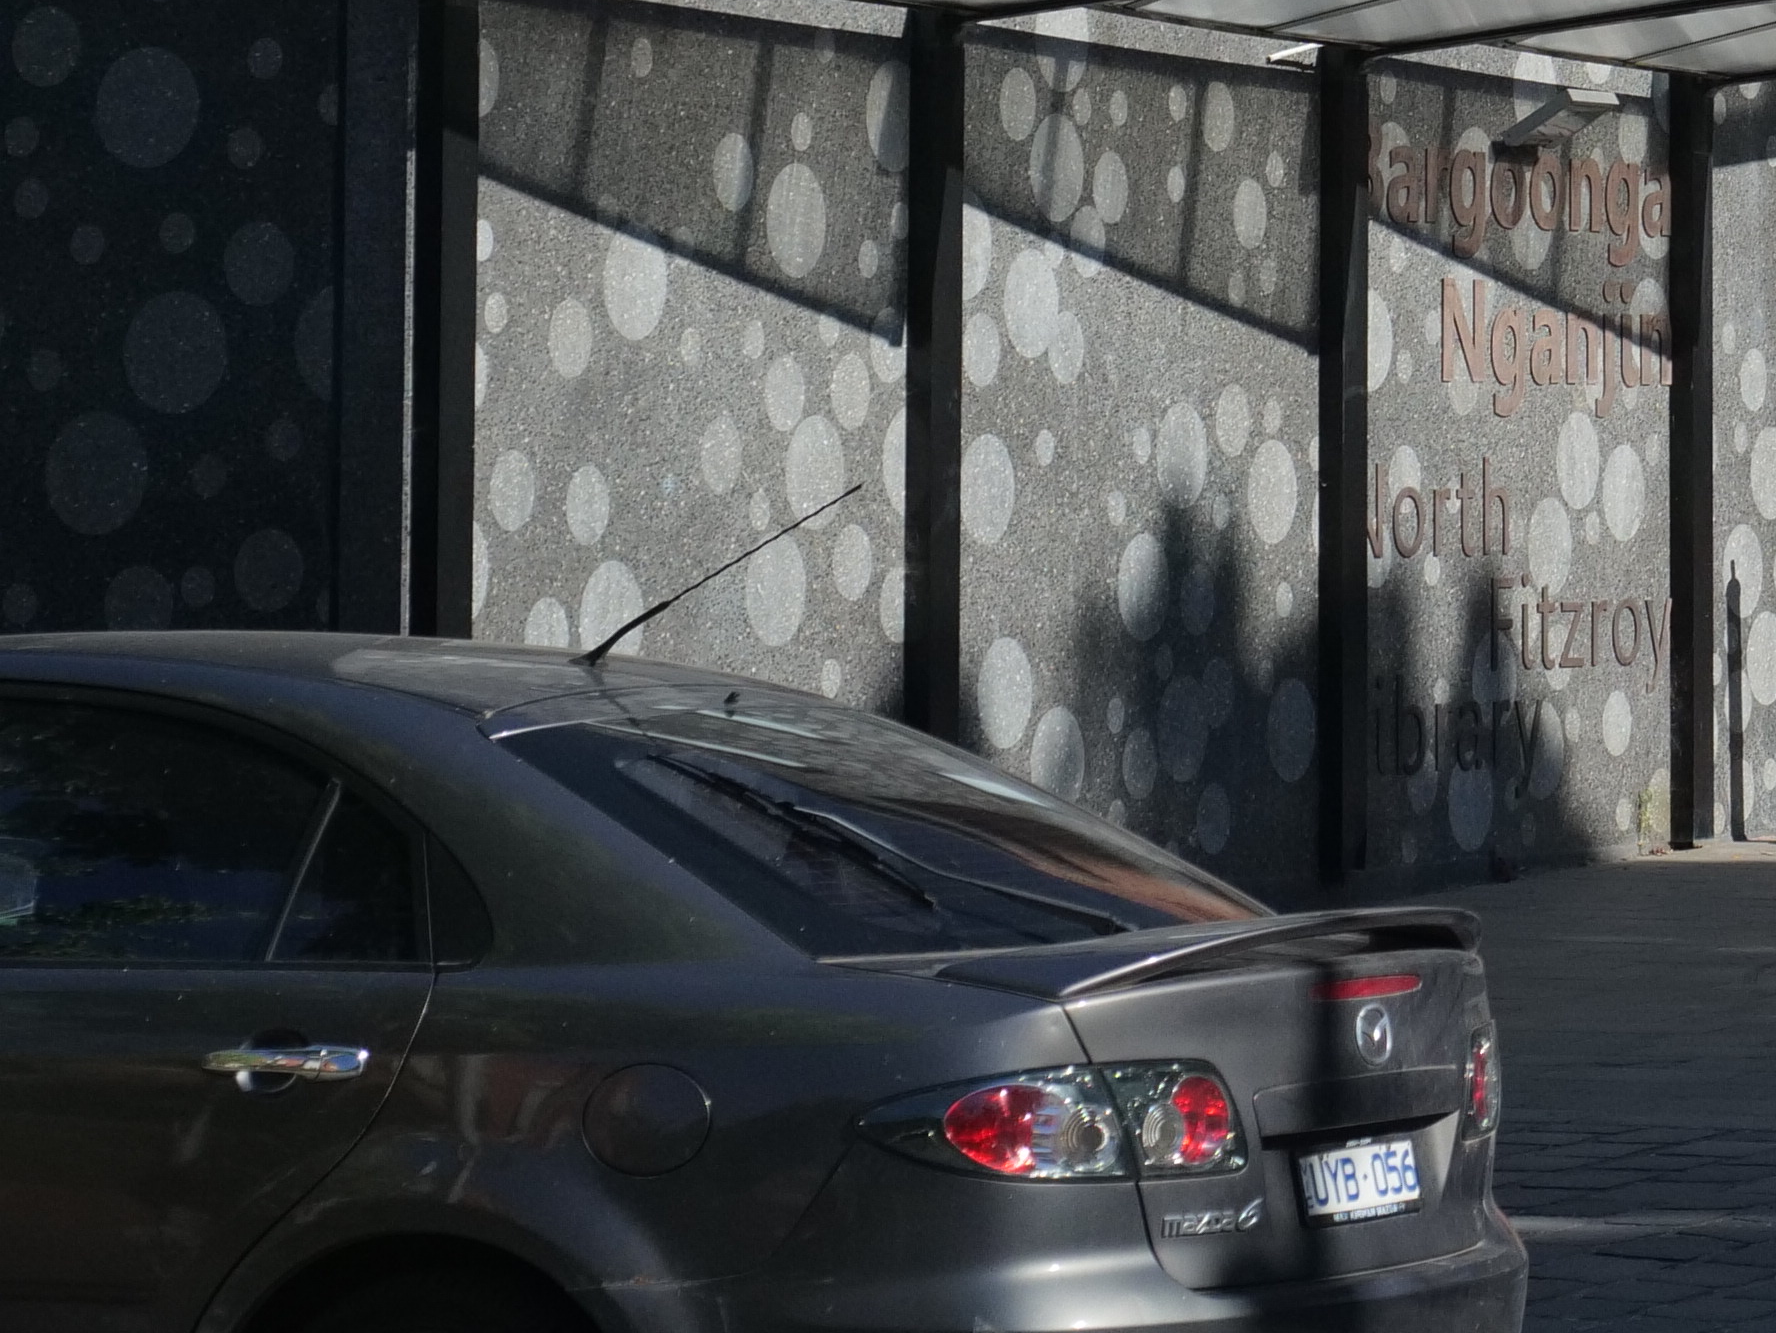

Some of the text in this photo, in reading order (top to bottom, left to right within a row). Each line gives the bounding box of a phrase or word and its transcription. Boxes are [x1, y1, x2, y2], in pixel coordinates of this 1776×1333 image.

[1440, 276, 1672, 418] Nganjin
[1489, 576, 1673, 691] Fitzroy
[1374, 672, 1544, 798] ibrary
